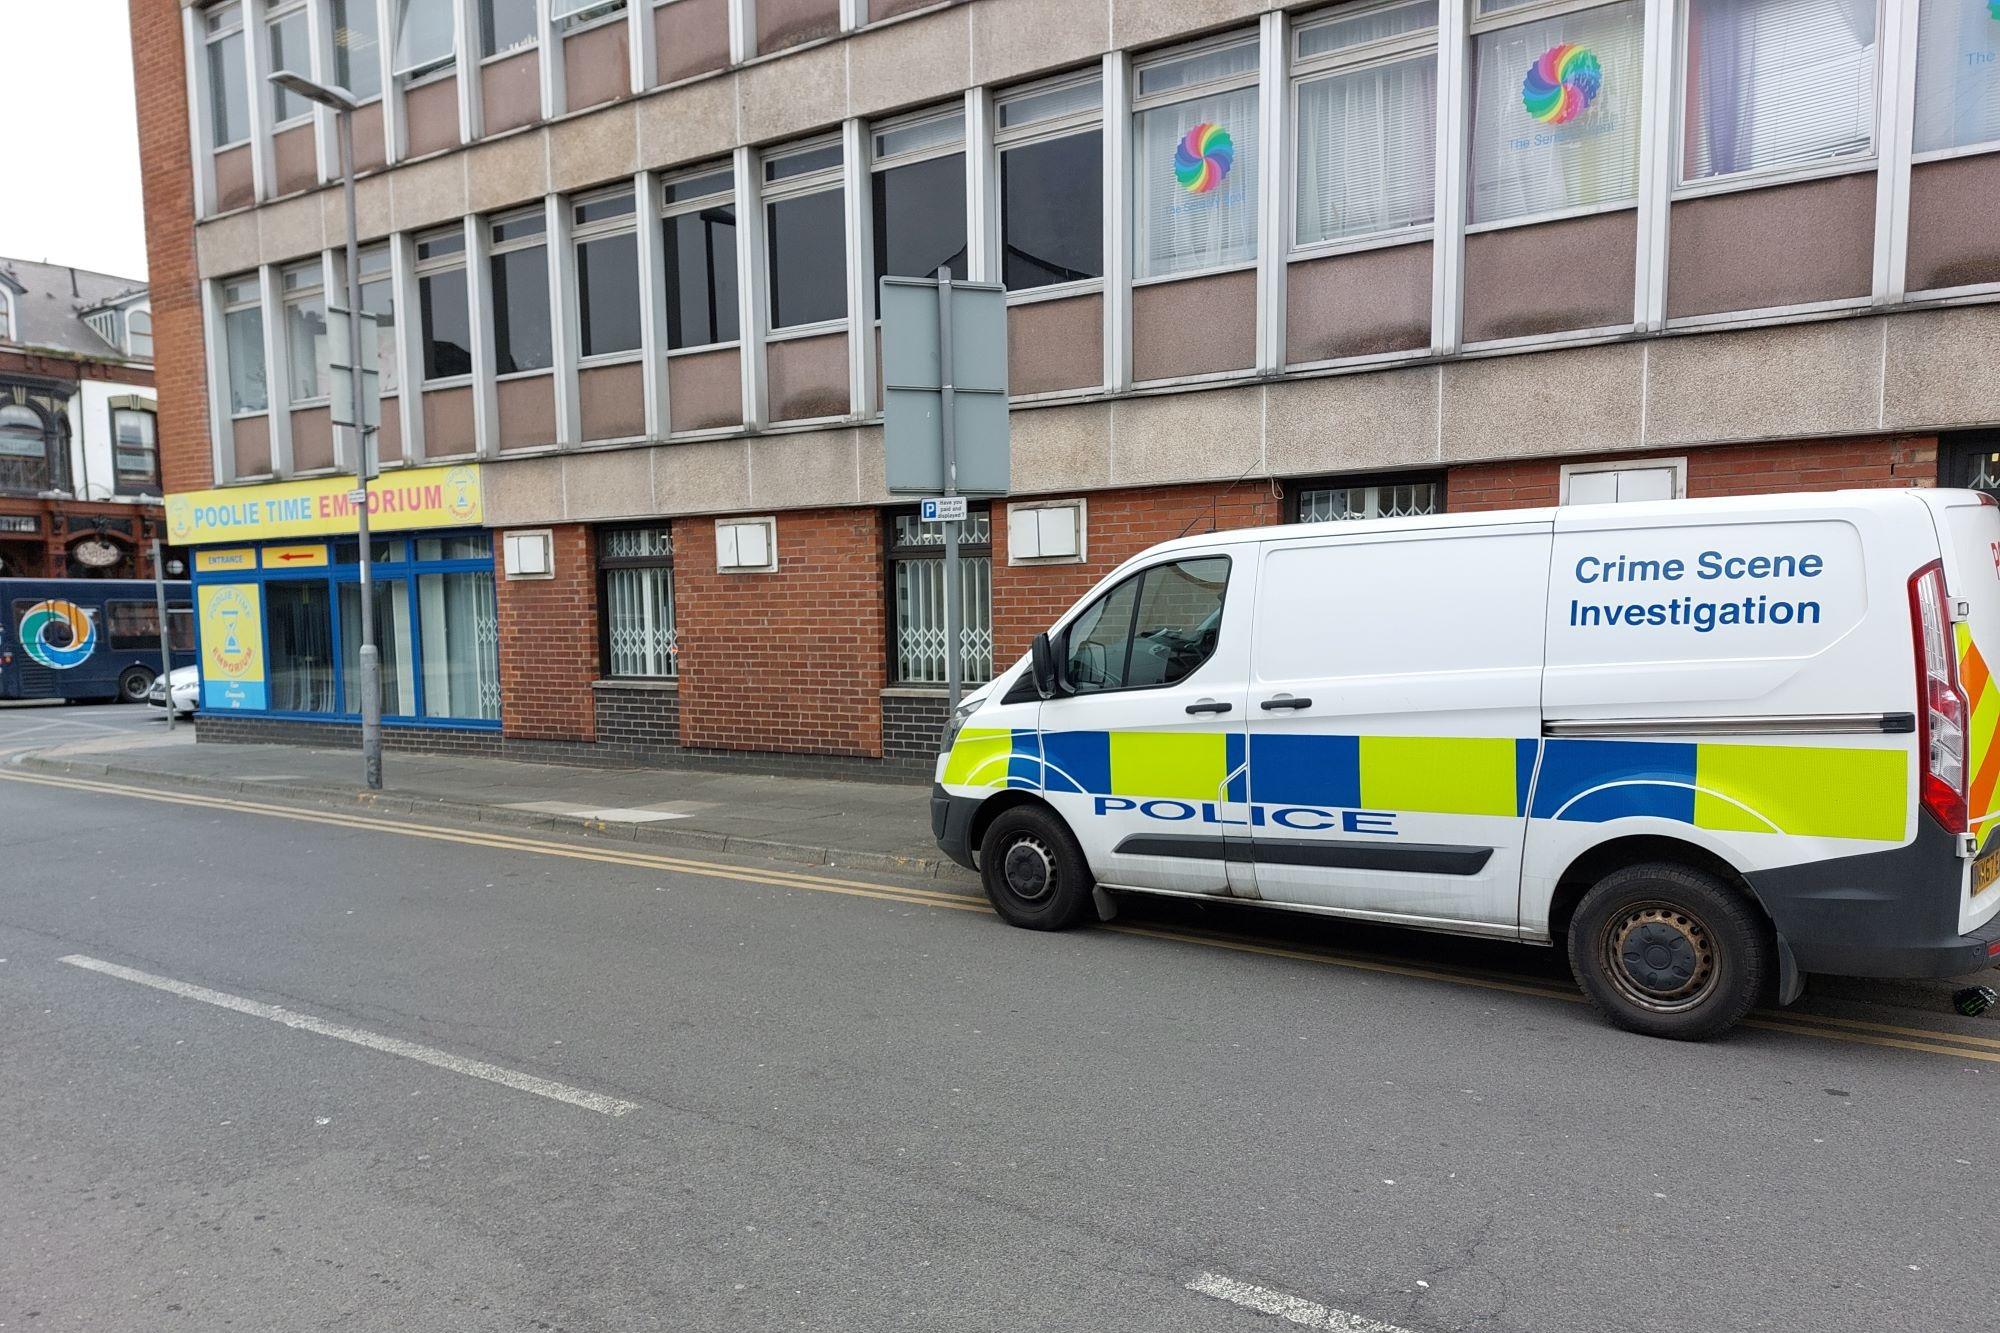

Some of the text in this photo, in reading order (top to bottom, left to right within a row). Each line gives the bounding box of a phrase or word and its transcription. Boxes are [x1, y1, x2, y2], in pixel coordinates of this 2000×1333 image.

[194, 502, 260, 529] POOLIE
[265, 497, 312, 522] TIME
[926, 503, 935, 517] P
[208, 554, 244, 565] ENTRANCE
[1575, 550, 1823, 583] Crime Scene
[1570, 595, 1821, 633] Investigation
[212, 646, 253, 673] EMPORIUM
[1094, 796, 1399, 835] POLICE
